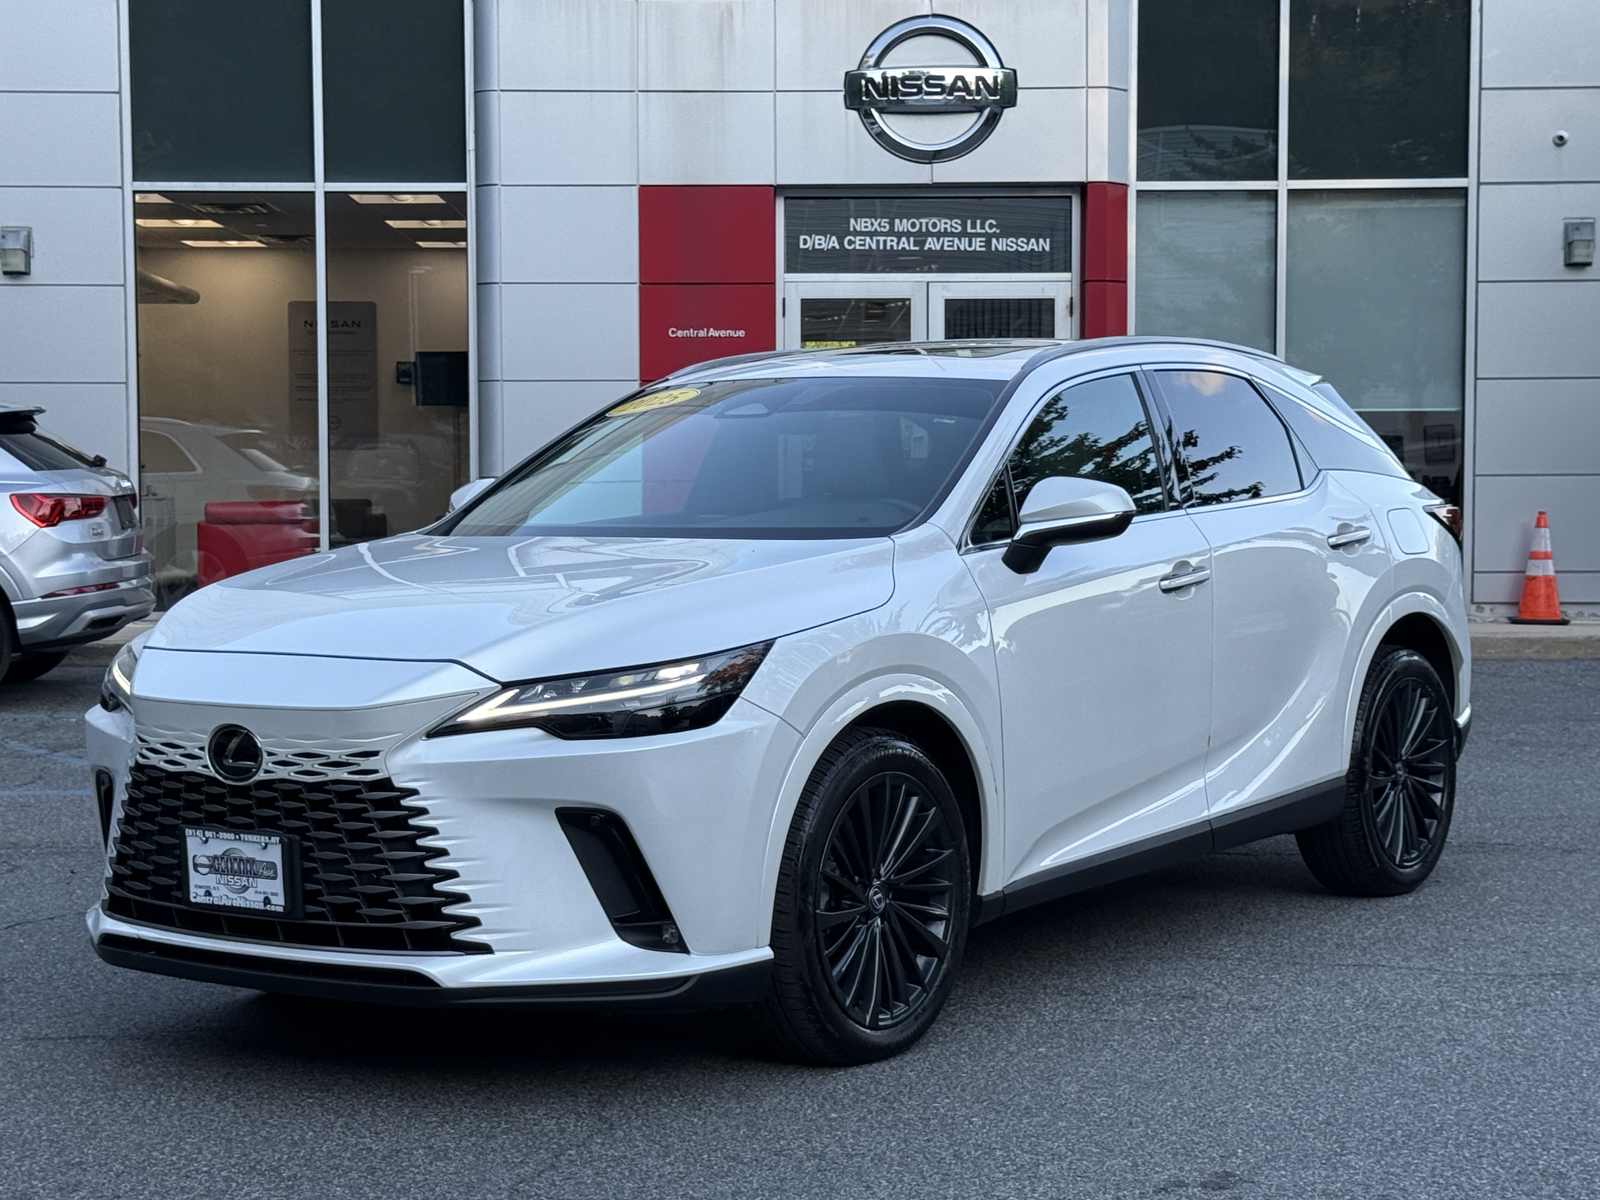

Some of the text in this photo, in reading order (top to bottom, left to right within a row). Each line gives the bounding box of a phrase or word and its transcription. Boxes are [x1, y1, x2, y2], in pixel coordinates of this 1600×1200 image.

[863, 74, 1000, 100] NISSAN
[849, 218, 1000, 234] NBX5 MOTORS LLC.
[799, 235, 1051, 252] D/B/A CENTRAL AVENUE NISSAN
[213, 855, 257, 875] CENTRAL
[216, 874, 257, 887] NISSAN
